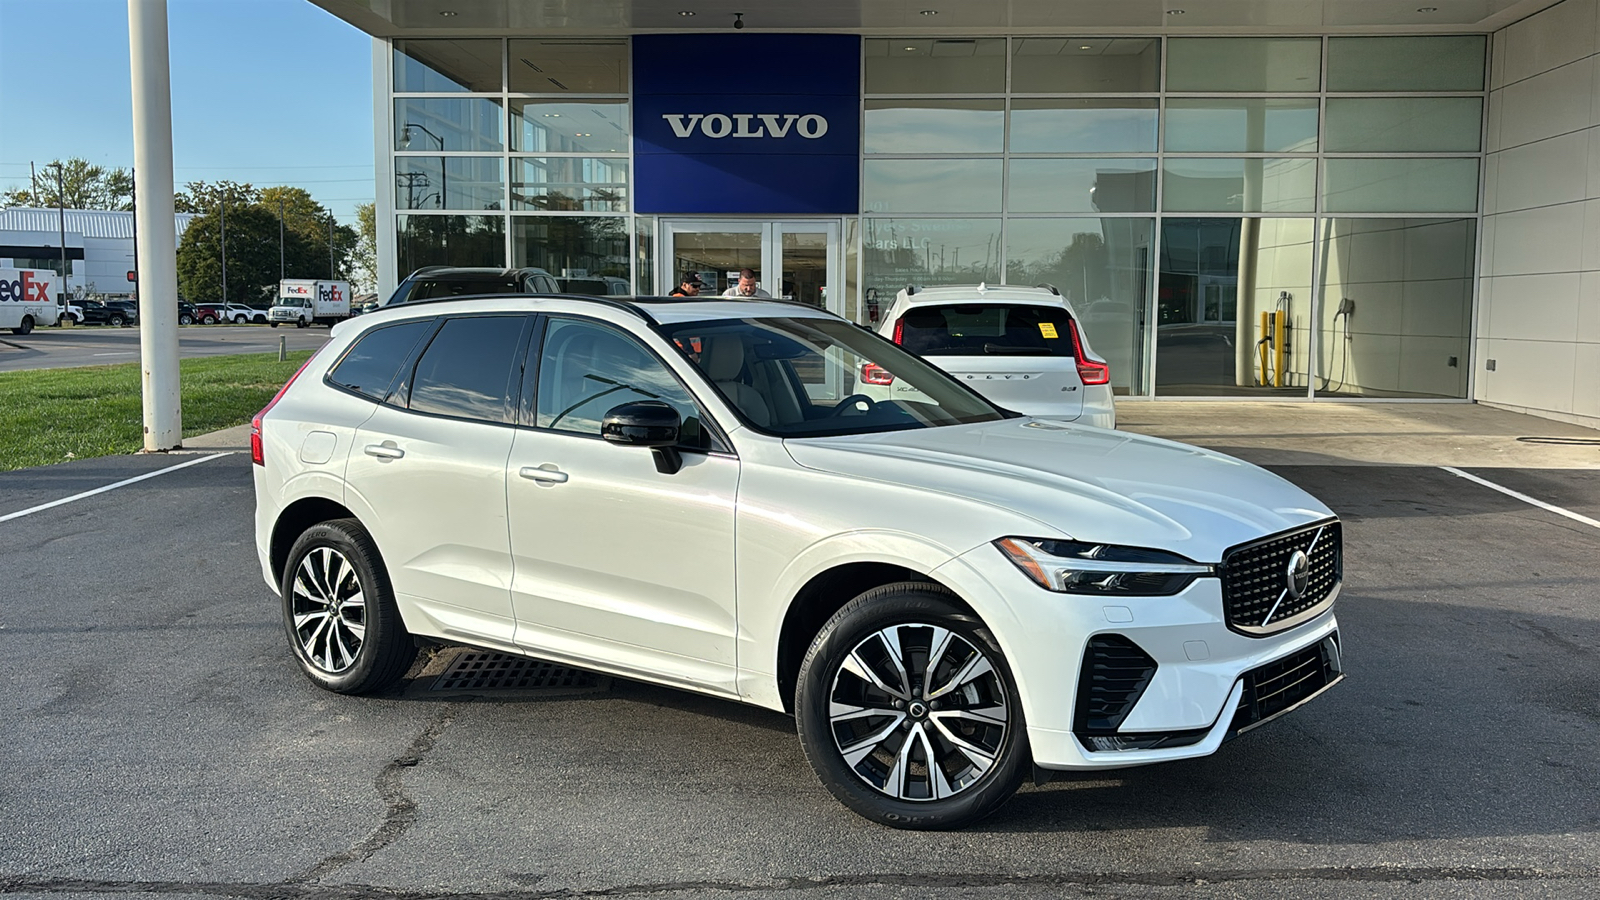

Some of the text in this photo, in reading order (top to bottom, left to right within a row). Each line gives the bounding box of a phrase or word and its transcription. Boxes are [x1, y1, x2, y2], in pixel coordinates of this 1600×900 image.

[662, 113, 828, 139] VOLVO
[0, 271, 50, 302] edEx
[287, 286, 308, 294] FedEx
[319, 285, 343, 302] FedEx
